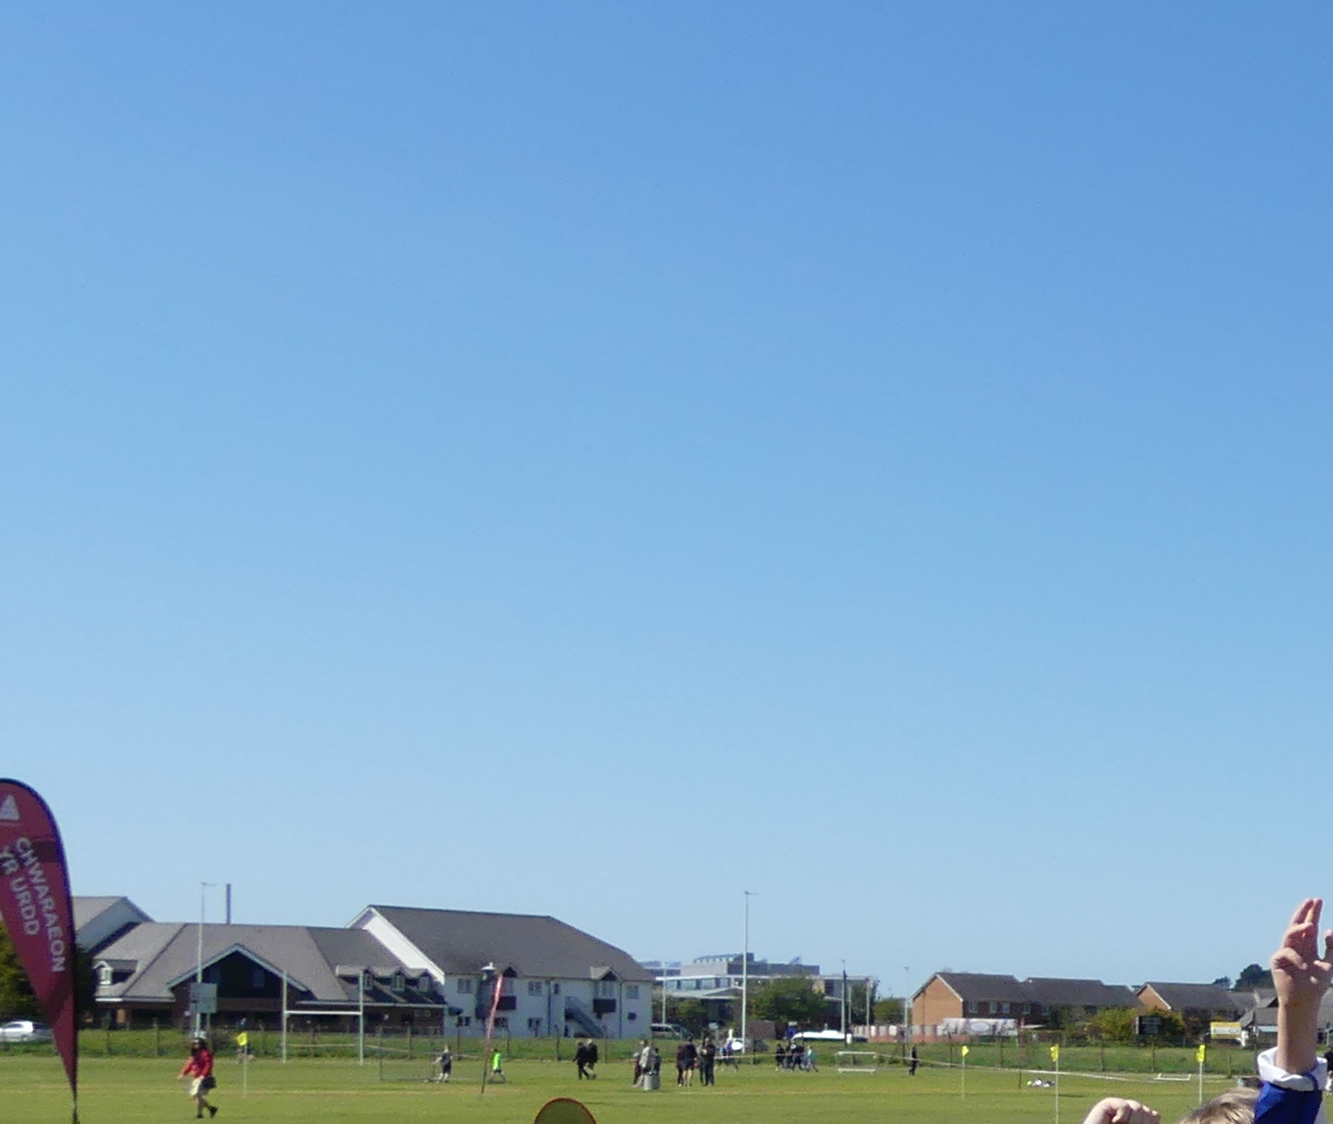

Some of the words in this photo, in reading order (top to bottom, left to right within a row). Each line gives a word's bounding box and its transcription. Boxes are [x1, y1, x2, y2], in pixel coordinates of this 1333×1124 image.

[0, 845, 20, 876] YR
[10, 877, 41, 936] URDD
[16, 836, 67, 972] CHWARAEON
